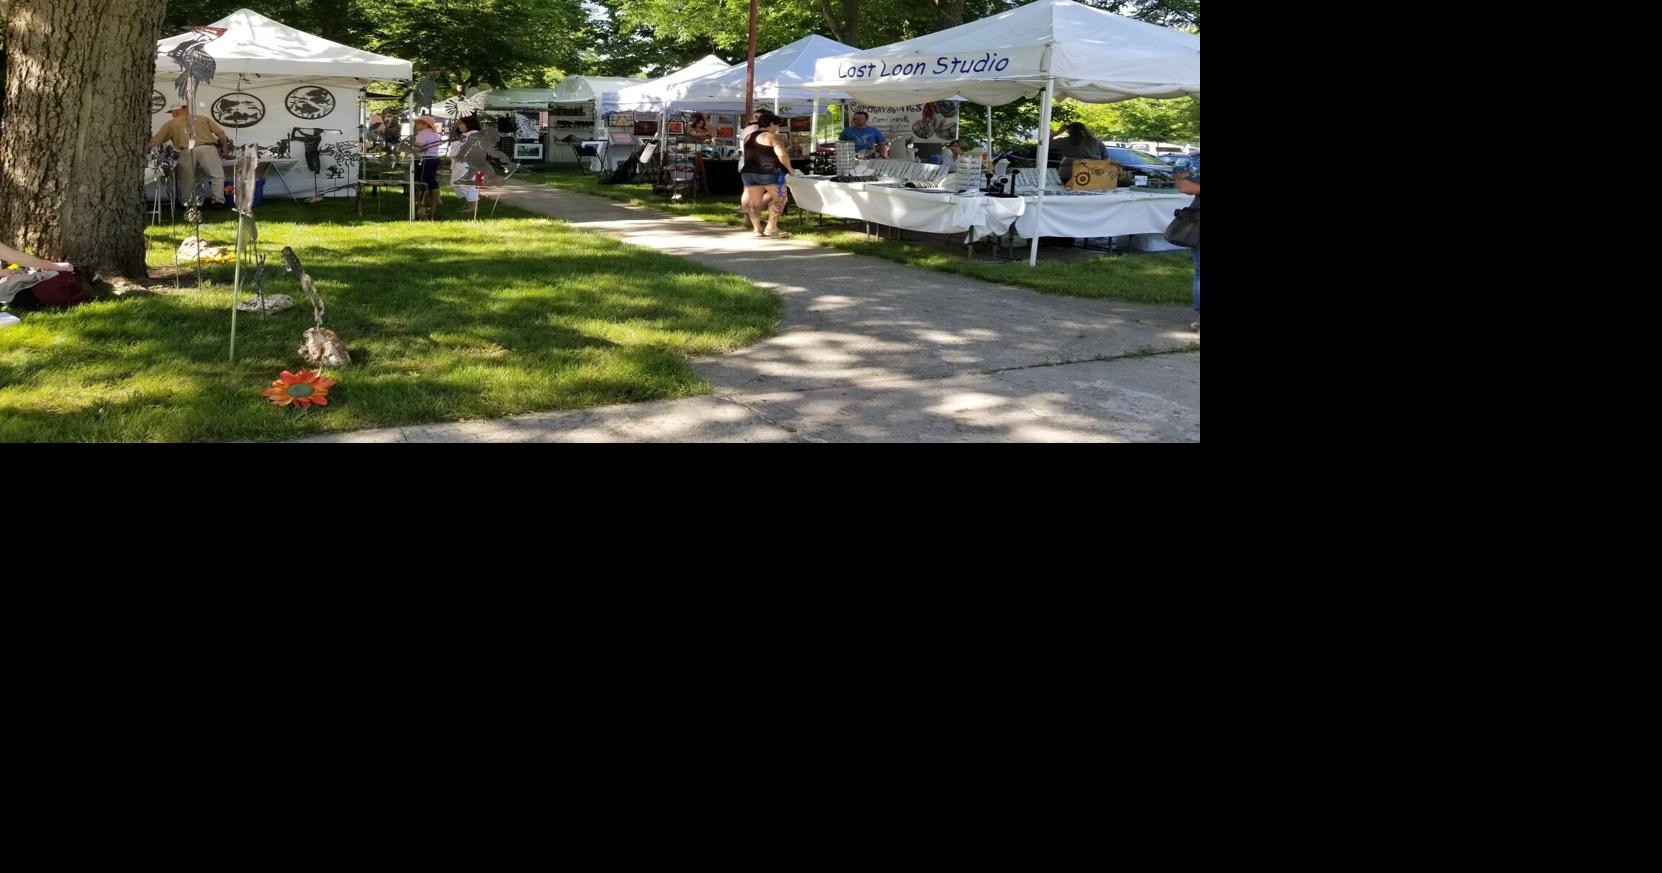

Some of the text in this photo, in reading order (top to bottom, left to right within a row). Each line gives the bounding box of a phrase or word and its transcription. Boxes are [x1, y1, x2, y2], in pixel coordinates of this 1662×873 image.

[838, 52, 1010, 79] Lost Loon Studio
